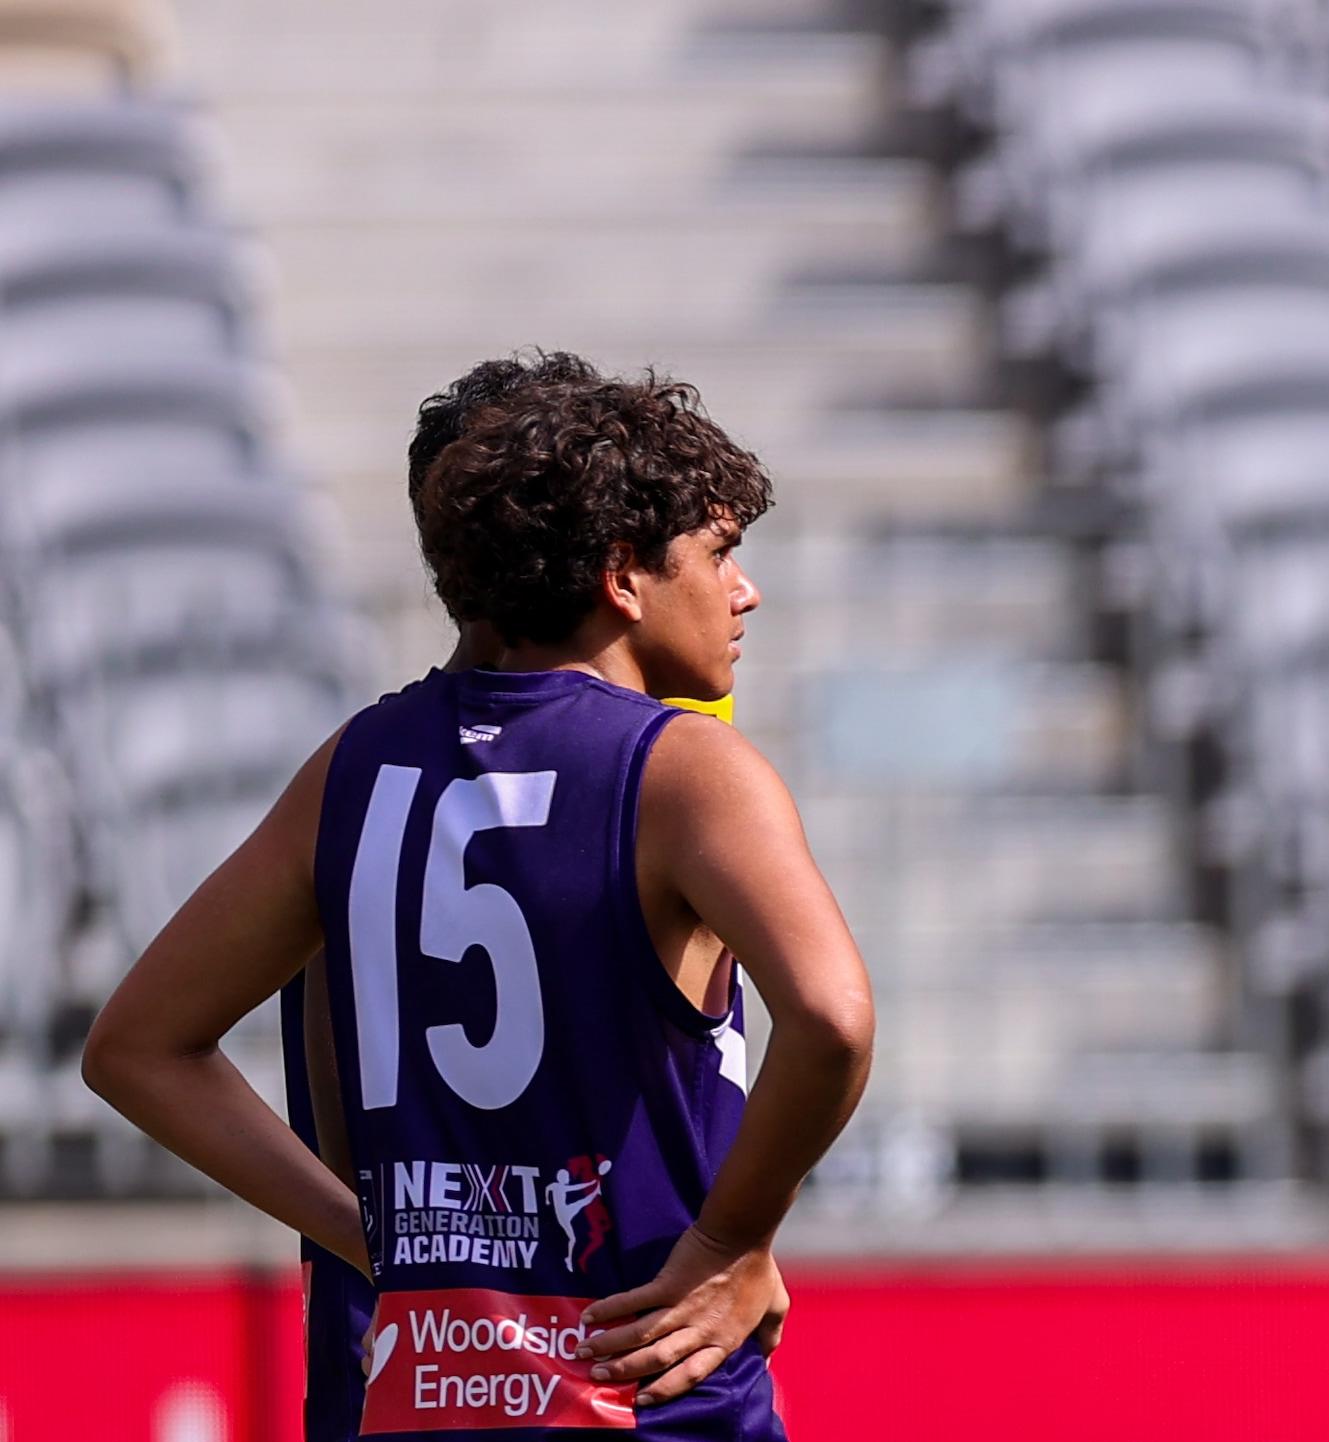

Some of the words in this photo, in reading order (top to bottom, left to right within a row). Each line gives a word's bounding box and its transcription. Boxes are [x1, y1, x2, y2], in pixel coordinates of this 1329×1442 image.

[348, 763, 558, 1112] 15
[393, 1160, 541, 1213] NEXT
[394, 1210, 540, 1239] GENERATION
[393, 1234, 539, 1269] ACADEMY
[408, 1307, 614, 1361] Woodsid
[414, 1364, 562, 1417] Energy
